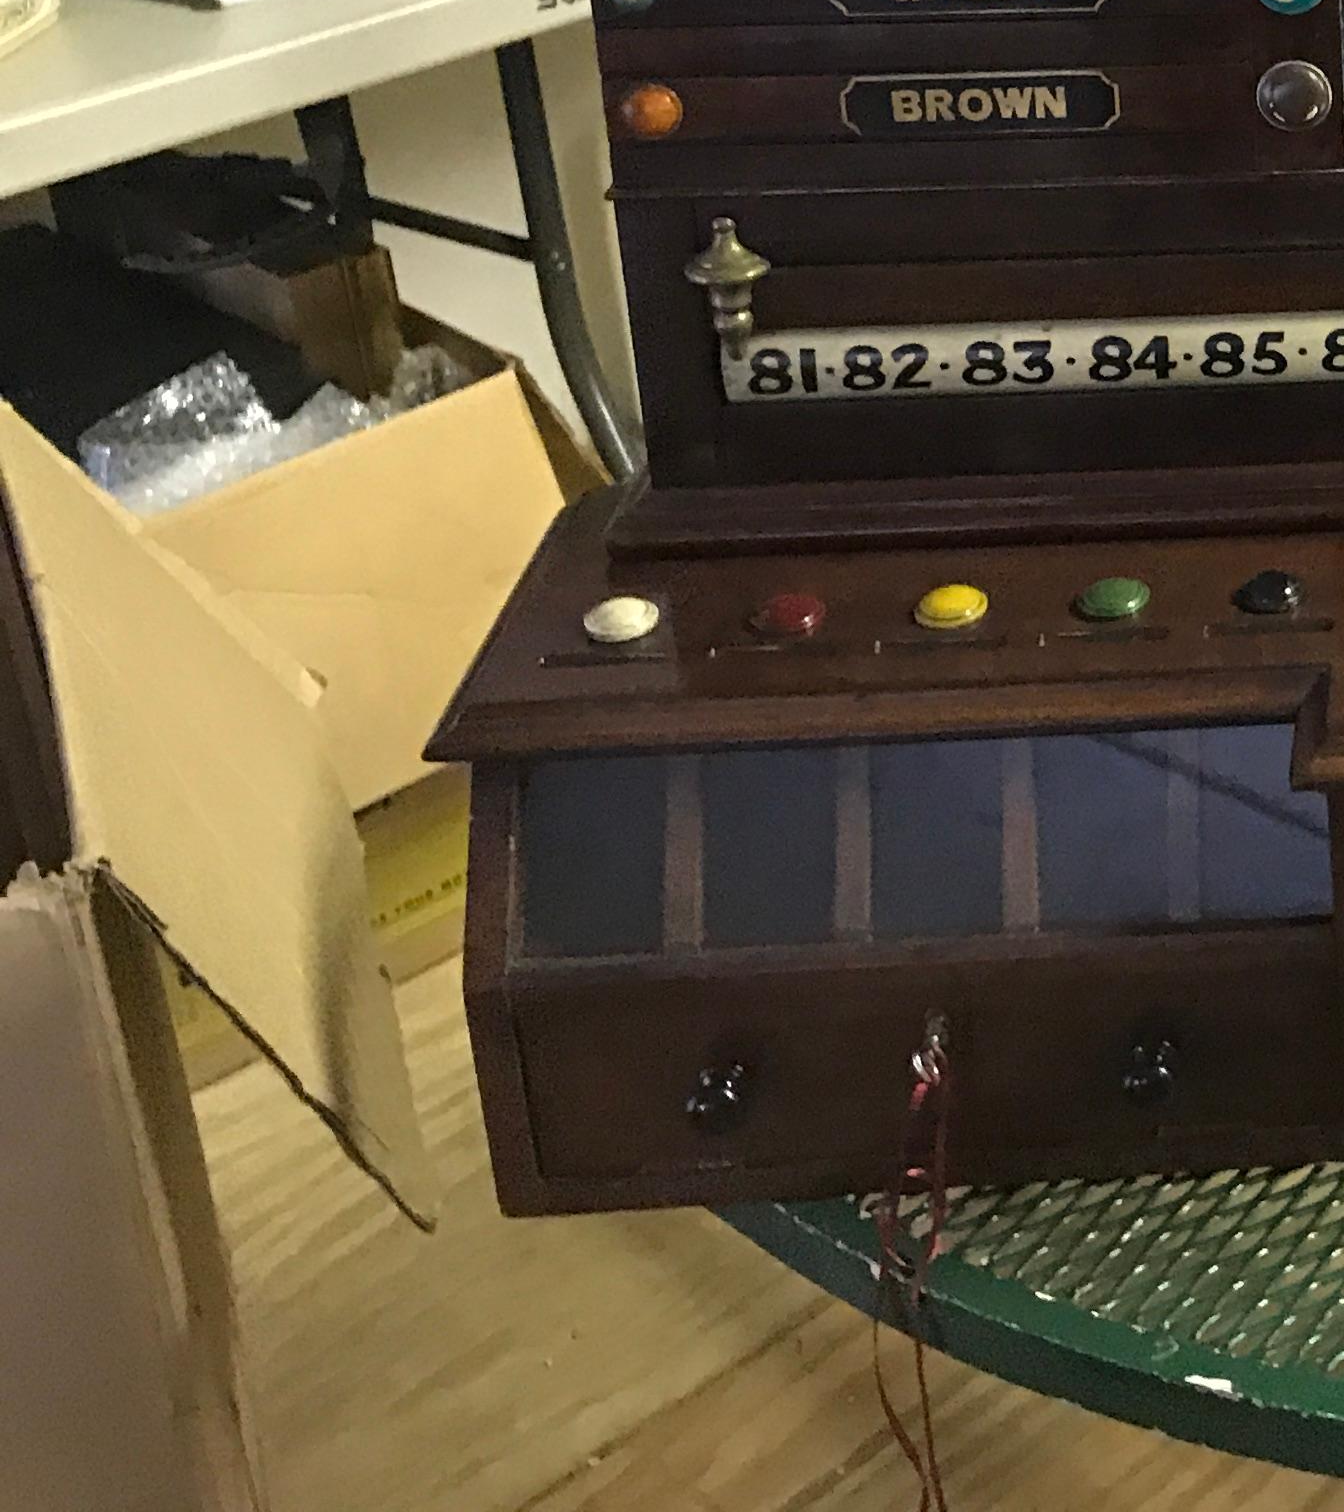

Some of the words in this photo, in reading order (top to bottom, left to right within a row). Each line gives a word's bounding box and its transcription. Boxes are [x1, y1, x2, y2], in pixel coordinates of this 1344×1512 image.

[890, 86, 1068, 122] BROWN
[748, 347, 817, 394] 81
[842, 344, 932, 389] 82
[961, 340, 1054, 386] 83
[1088, 336, 1178, 383] 84
[1200, 332, 1286, 379] 85
